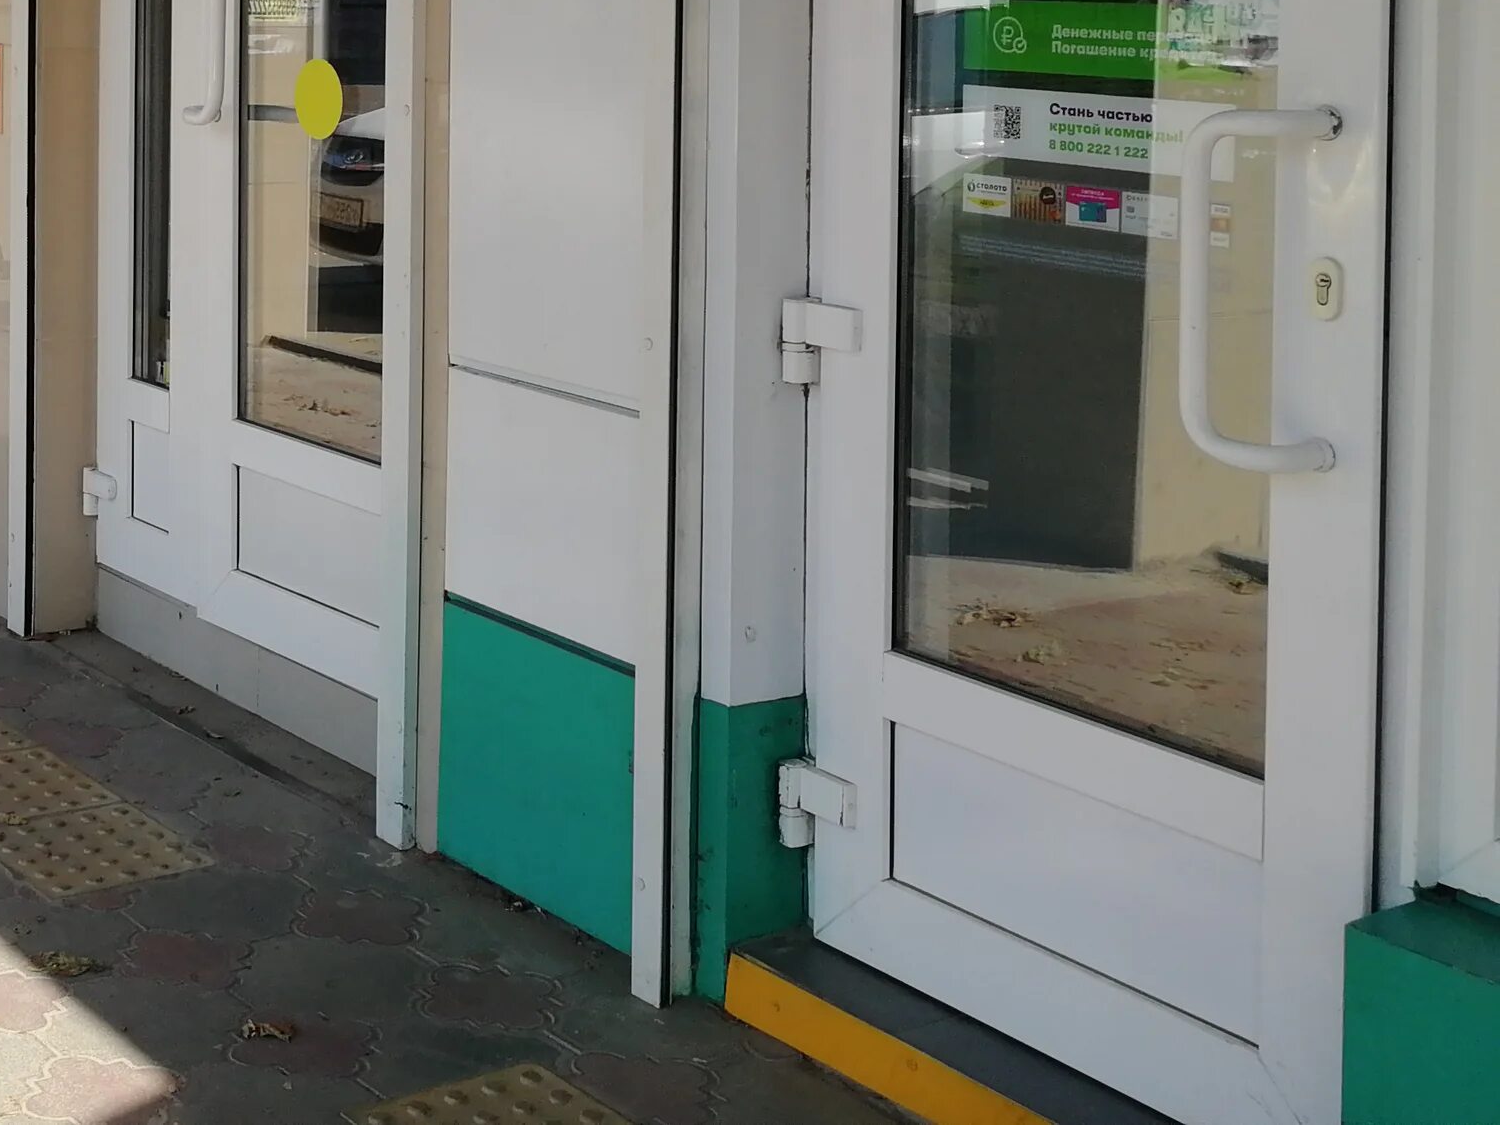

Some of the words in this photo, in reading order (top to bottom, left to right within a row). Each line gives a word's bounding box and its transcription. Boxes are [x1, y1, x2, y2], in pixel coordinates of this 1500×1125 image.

[1051, 24, 1133, 40] Денежные
[1051, 41, 1136, 57] Погашение
[1049, 103, 1094, 118] Стань
[1098, 110, 1153, 123] частью
[1049, 121, 1101, 136] крутой
[1104, 126, 1184, 142] команды!
[1049, 139, 1056, 150] 8
[1060, 141, 1083, 153] 800
[1087, 143, 1111, 156] 222
[1115, 146, 1120, 156] 1
[1124, 147, 1149, 159] 222
